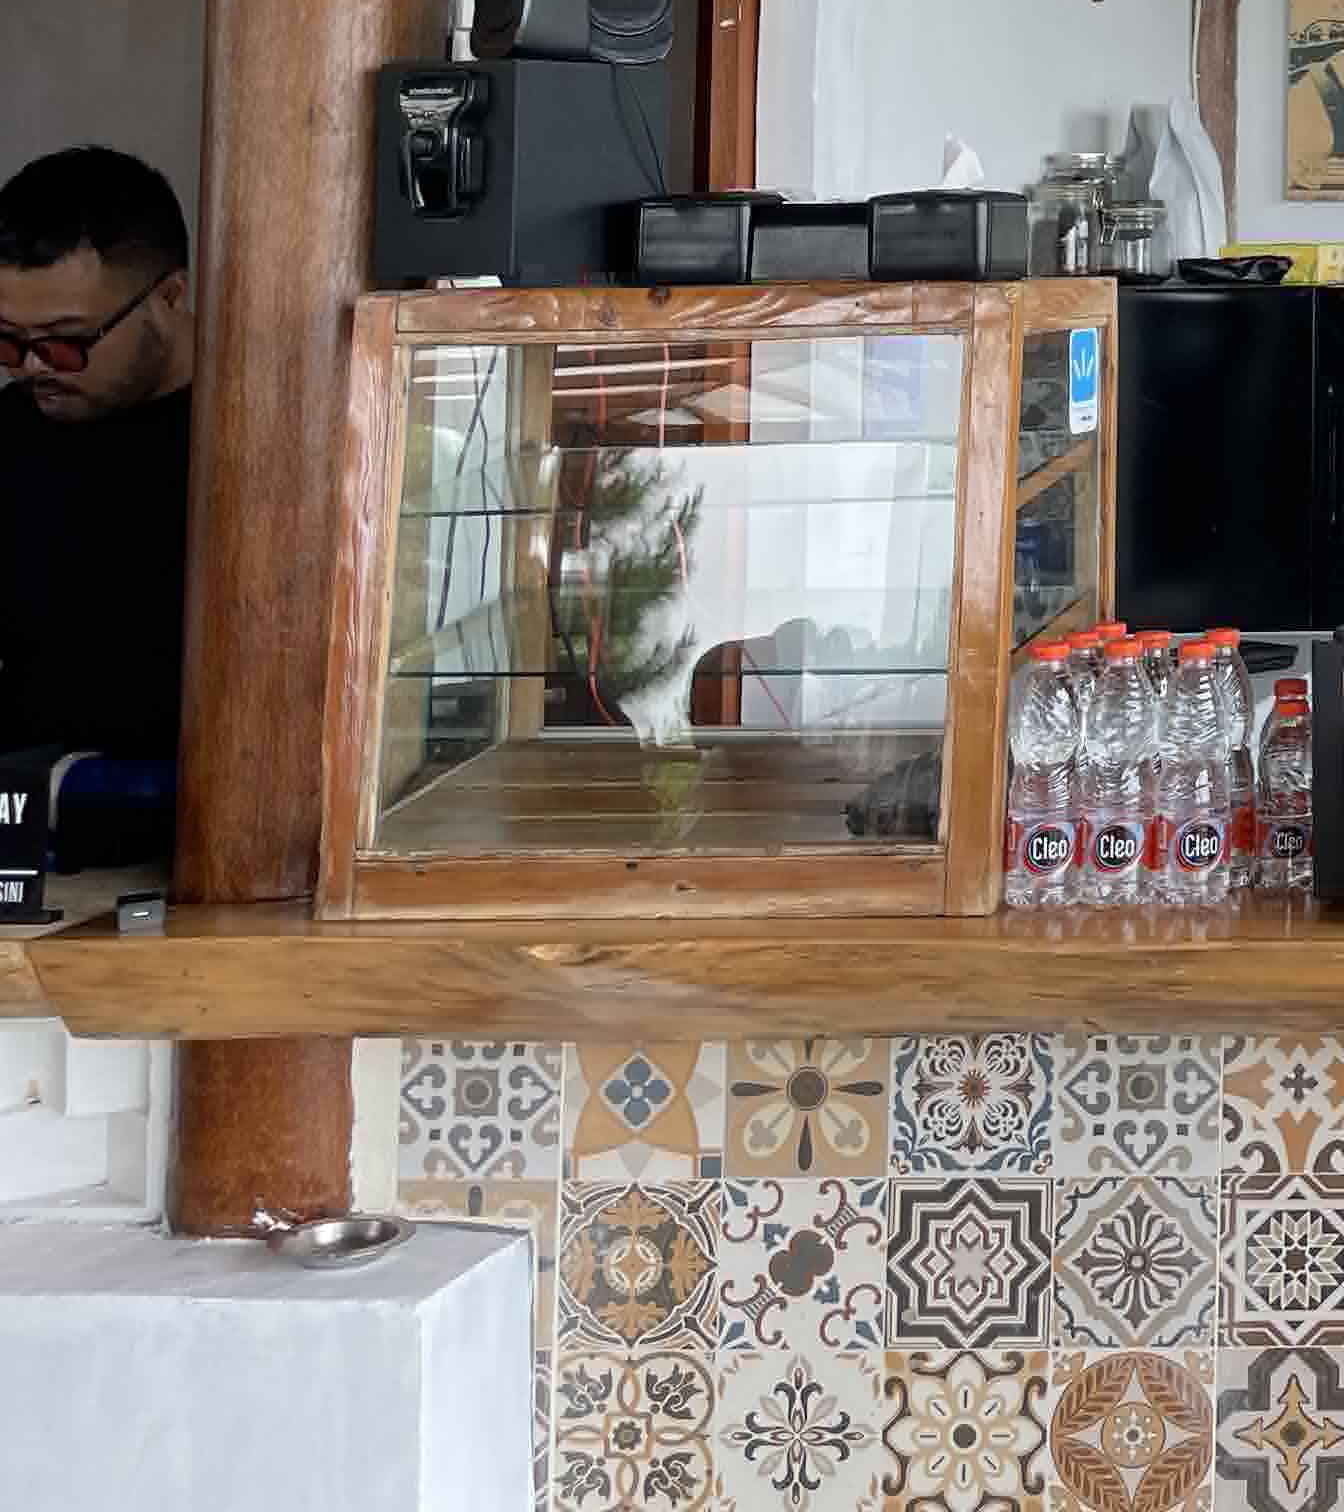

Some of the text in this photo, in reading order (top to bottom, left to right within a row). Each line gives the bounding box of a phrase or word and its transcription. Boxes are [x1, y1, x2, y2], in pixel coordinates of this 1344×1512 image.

[0, 791, 28, 825] AY
[1031, 836, 1068, 861] Cleo
[1098, 834, 1136, 859] Cleo
[1184, 833, 1219, 857] Cleo
[1275, 831, 1304, 851] Cleo
